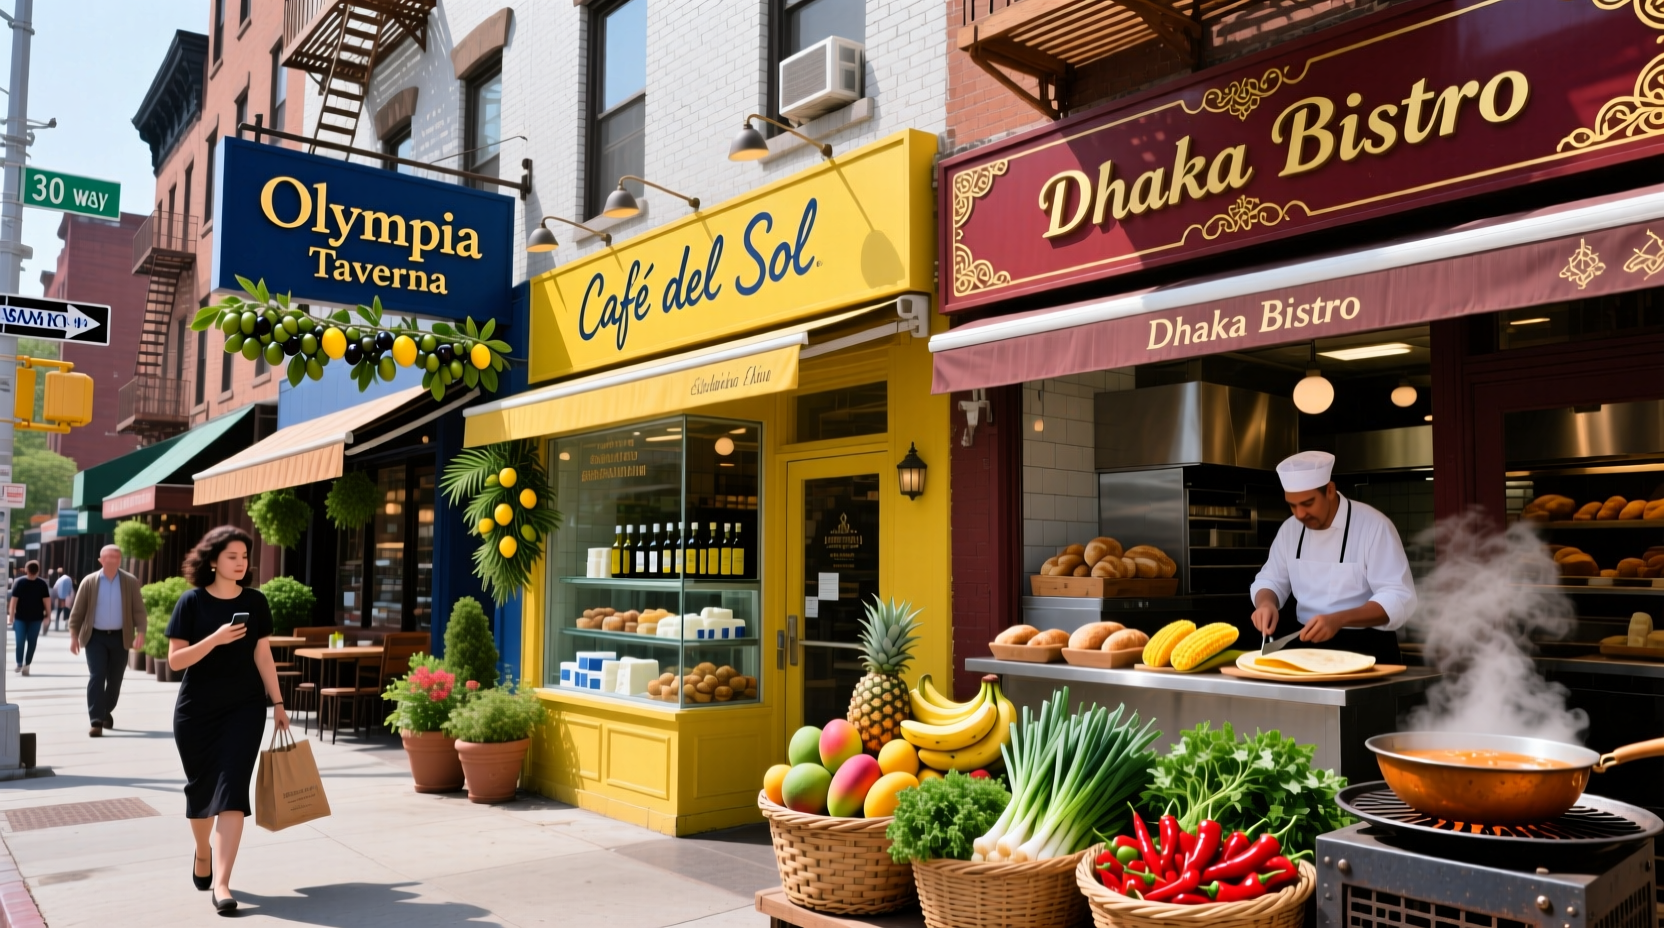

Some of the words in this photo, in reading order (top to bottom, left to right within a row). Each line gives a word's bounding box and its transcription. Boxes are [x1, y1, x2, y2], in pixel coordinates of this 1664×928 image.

[32, 174, 65, 205] 30
[1038, 135, 1254, 240] Dhaka
[1270, 70, 1531, 178] Bistro
[260, 176, 483, 263] Olympia
[308, 246, 448, 295] Taverna
[578, 258, 655, 350] Café
[662, 234, 724, 314] del
[735, 197, 818, 296] Sol
[1146, 309, 1248, 350] Dhaka
[1258, 296, 1361, 333] Bistro
